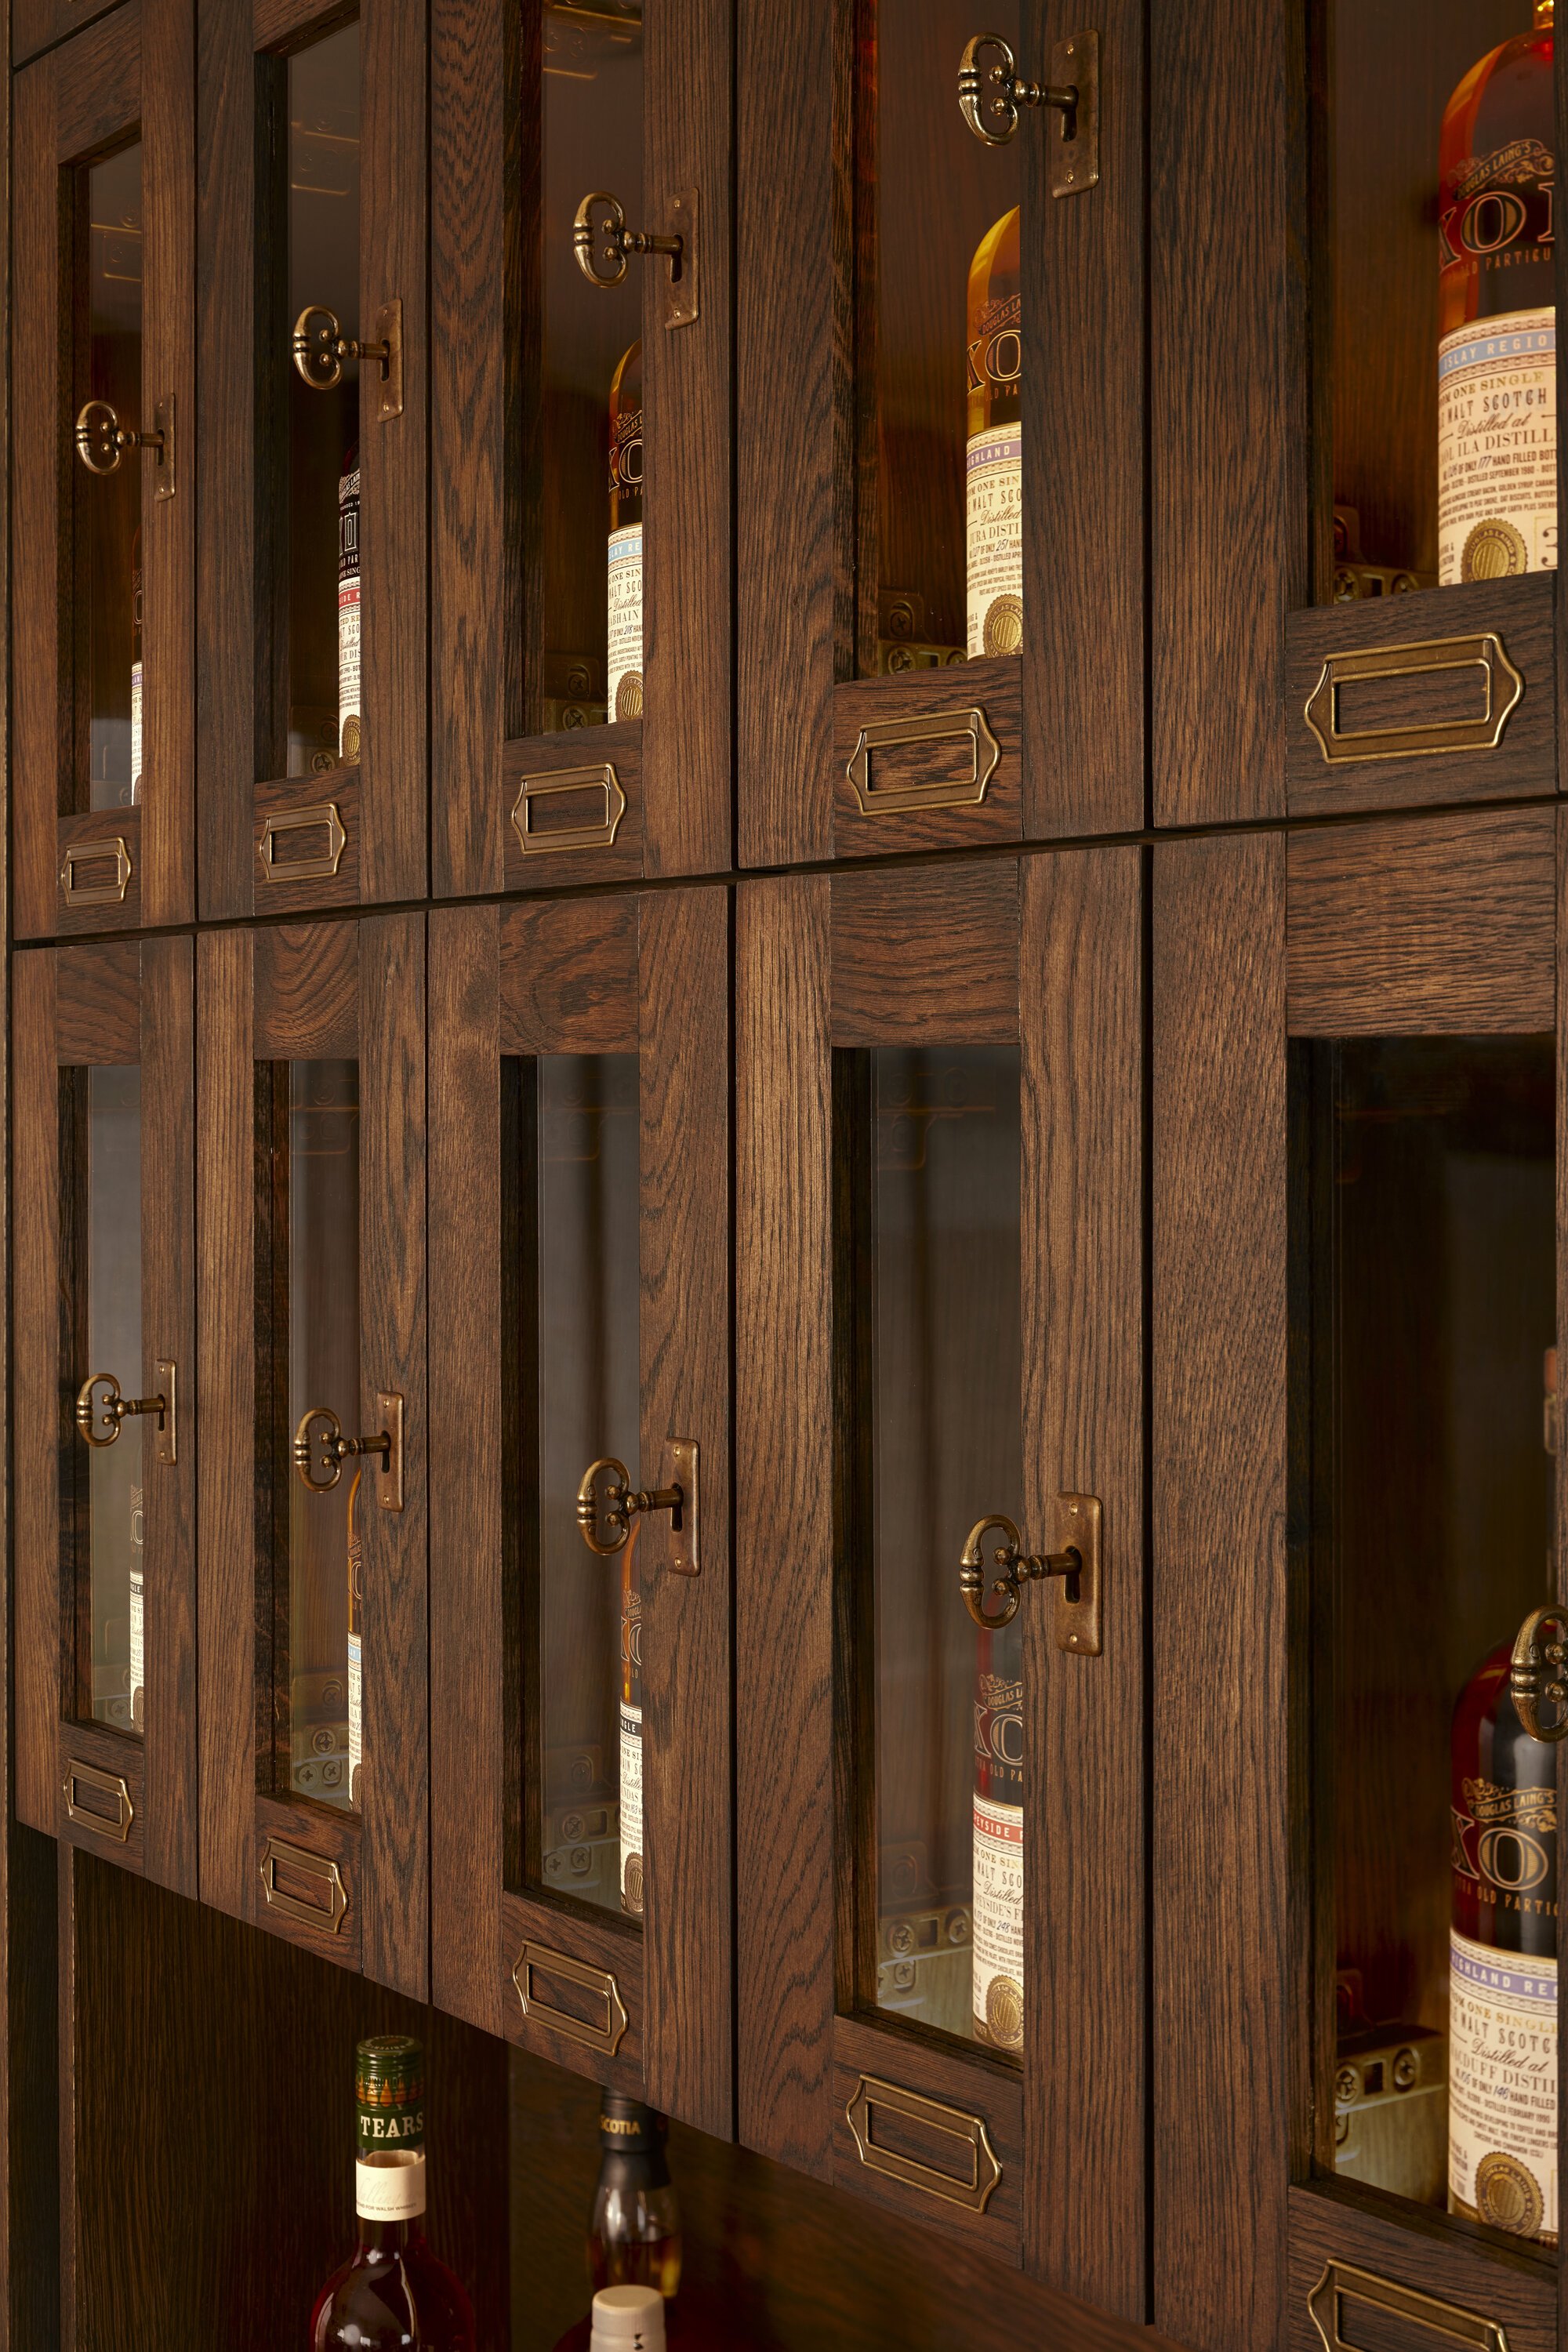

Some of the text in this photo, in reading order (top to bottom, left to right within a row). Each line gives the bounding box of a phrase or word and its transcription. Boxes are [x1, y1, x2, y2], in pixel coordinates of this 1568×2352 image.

[1457, 140, 1531, 199] DOUGLAS LAING'S
[982, 305, 1010, 335] DOUGLAS
[1443, 334, 1555, 370] ISLAY REGIO
[1454, 371, 1544, 400] ONE SINGLE
[1447, 388, 1547, 423] MALT SCOTCH
[617, 420, 638, 442] DOUGLAS
[1457, 412, 1532, 440] Distilled at
[1457, 428, 1555, 457] ILA DISTILL
[1465, 459, 1477, 473] ONLY
[1492, 454, 1511, 466] HAND
[1512, 451, 1537, 463] FILLED
[978, 475, 1019, 493] ONE SIN
[1468, 472, 1488, 484] DISTILLED
[1490, 468, 1519, 480] SEPTEMBER
[973, 493, 993, 512] MALT
[980, 504, 1022, 526] Distilled
[988, 1690, 1014, 1707] DOUGLAS
[990, 1763, 1004, 1778] OLD
[1475, 1791, 1555, 1819] DOUGLAS LAING'S
[981, 1849, 1023, 1870] ONE SIN
[1450, 1806, 1548, 1890] XO
[977, 1860, 1022, 1889] MALT SCO
[983, 1880, 1023, 1906] Distilled
[1477, 1886, 1497, 1904] OLD
[996, 1920, 1011, 1933] 248
[1452, 1953, 1511, 1988] HIGHLAND
[1468, 2001, 1491, 2020] ONE
[1461, 2012, 1489, 2038] MALT
[1472, 2038, 1549, 2073] Distilled at
[1485, 2099, 1506, 2114] DISTILLED
[1508, 2106, 1534, 2120] FEBRUARY
[1510, 2091, 1529, 2105] HAND
[1530, 2096, 1555, 2111] FILLED
[360, 2111, 424, 2139] TEARS
[601, 2114, 641, 2136] SCOTIA
